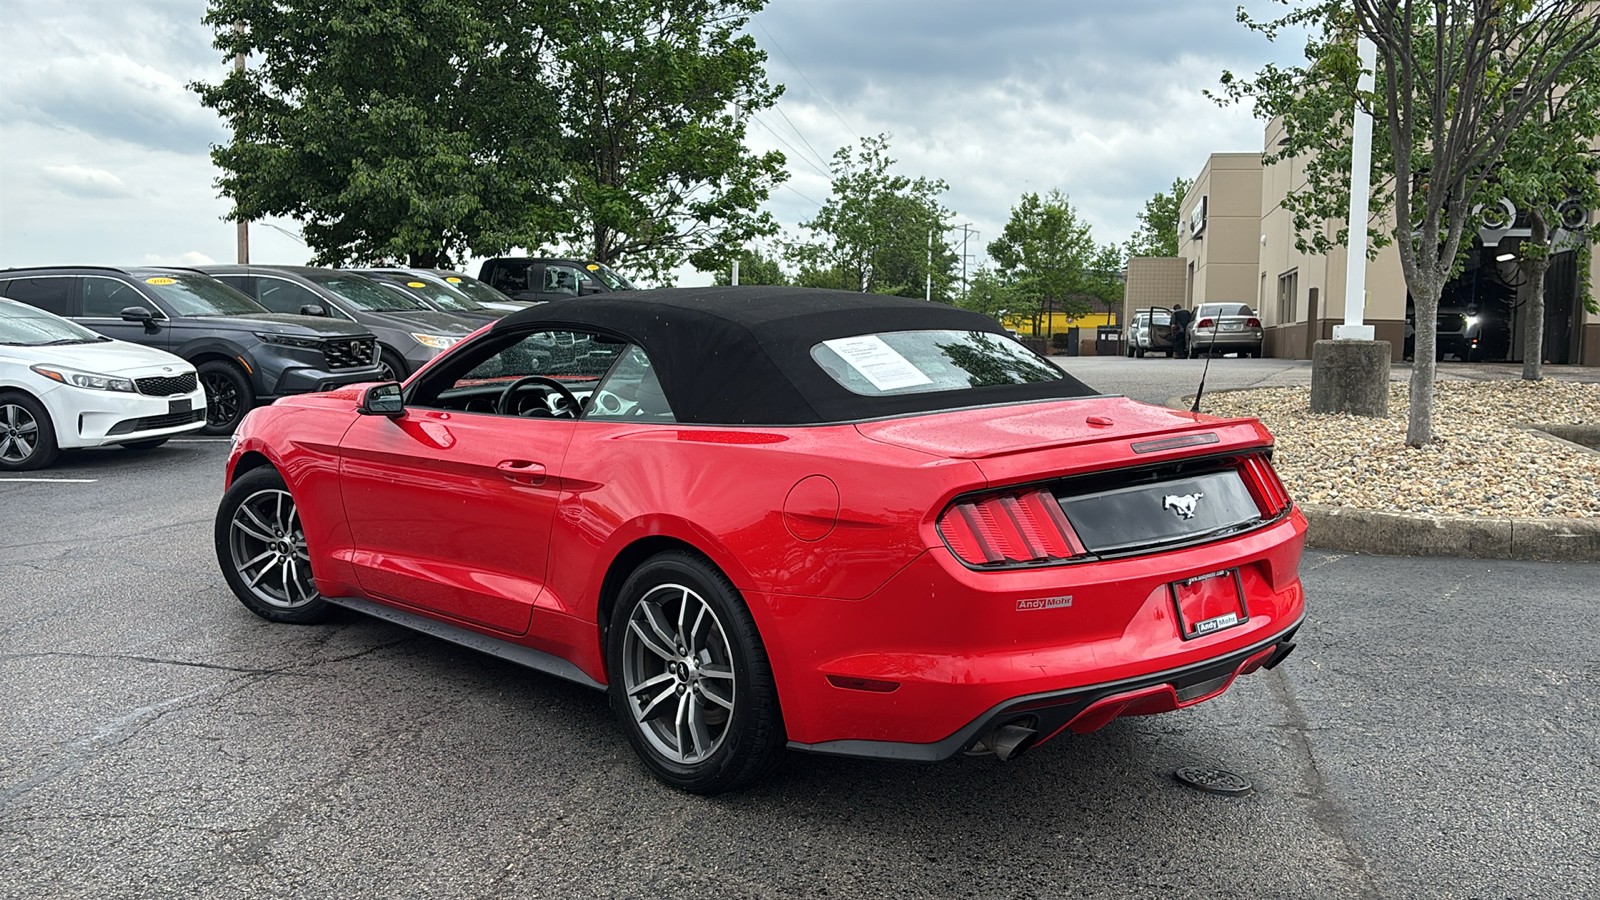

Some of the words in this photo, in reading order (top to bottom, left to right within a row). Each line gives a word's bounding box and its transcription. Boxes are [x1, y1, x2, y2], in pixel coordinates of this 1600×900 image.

[1018, 599, 1046, 609] Andy
[1047, 597, 1071, 606] Mohr
[1200, 620, 1218, 632] Andy
[1218, 616, 1236, 627] Mohr
